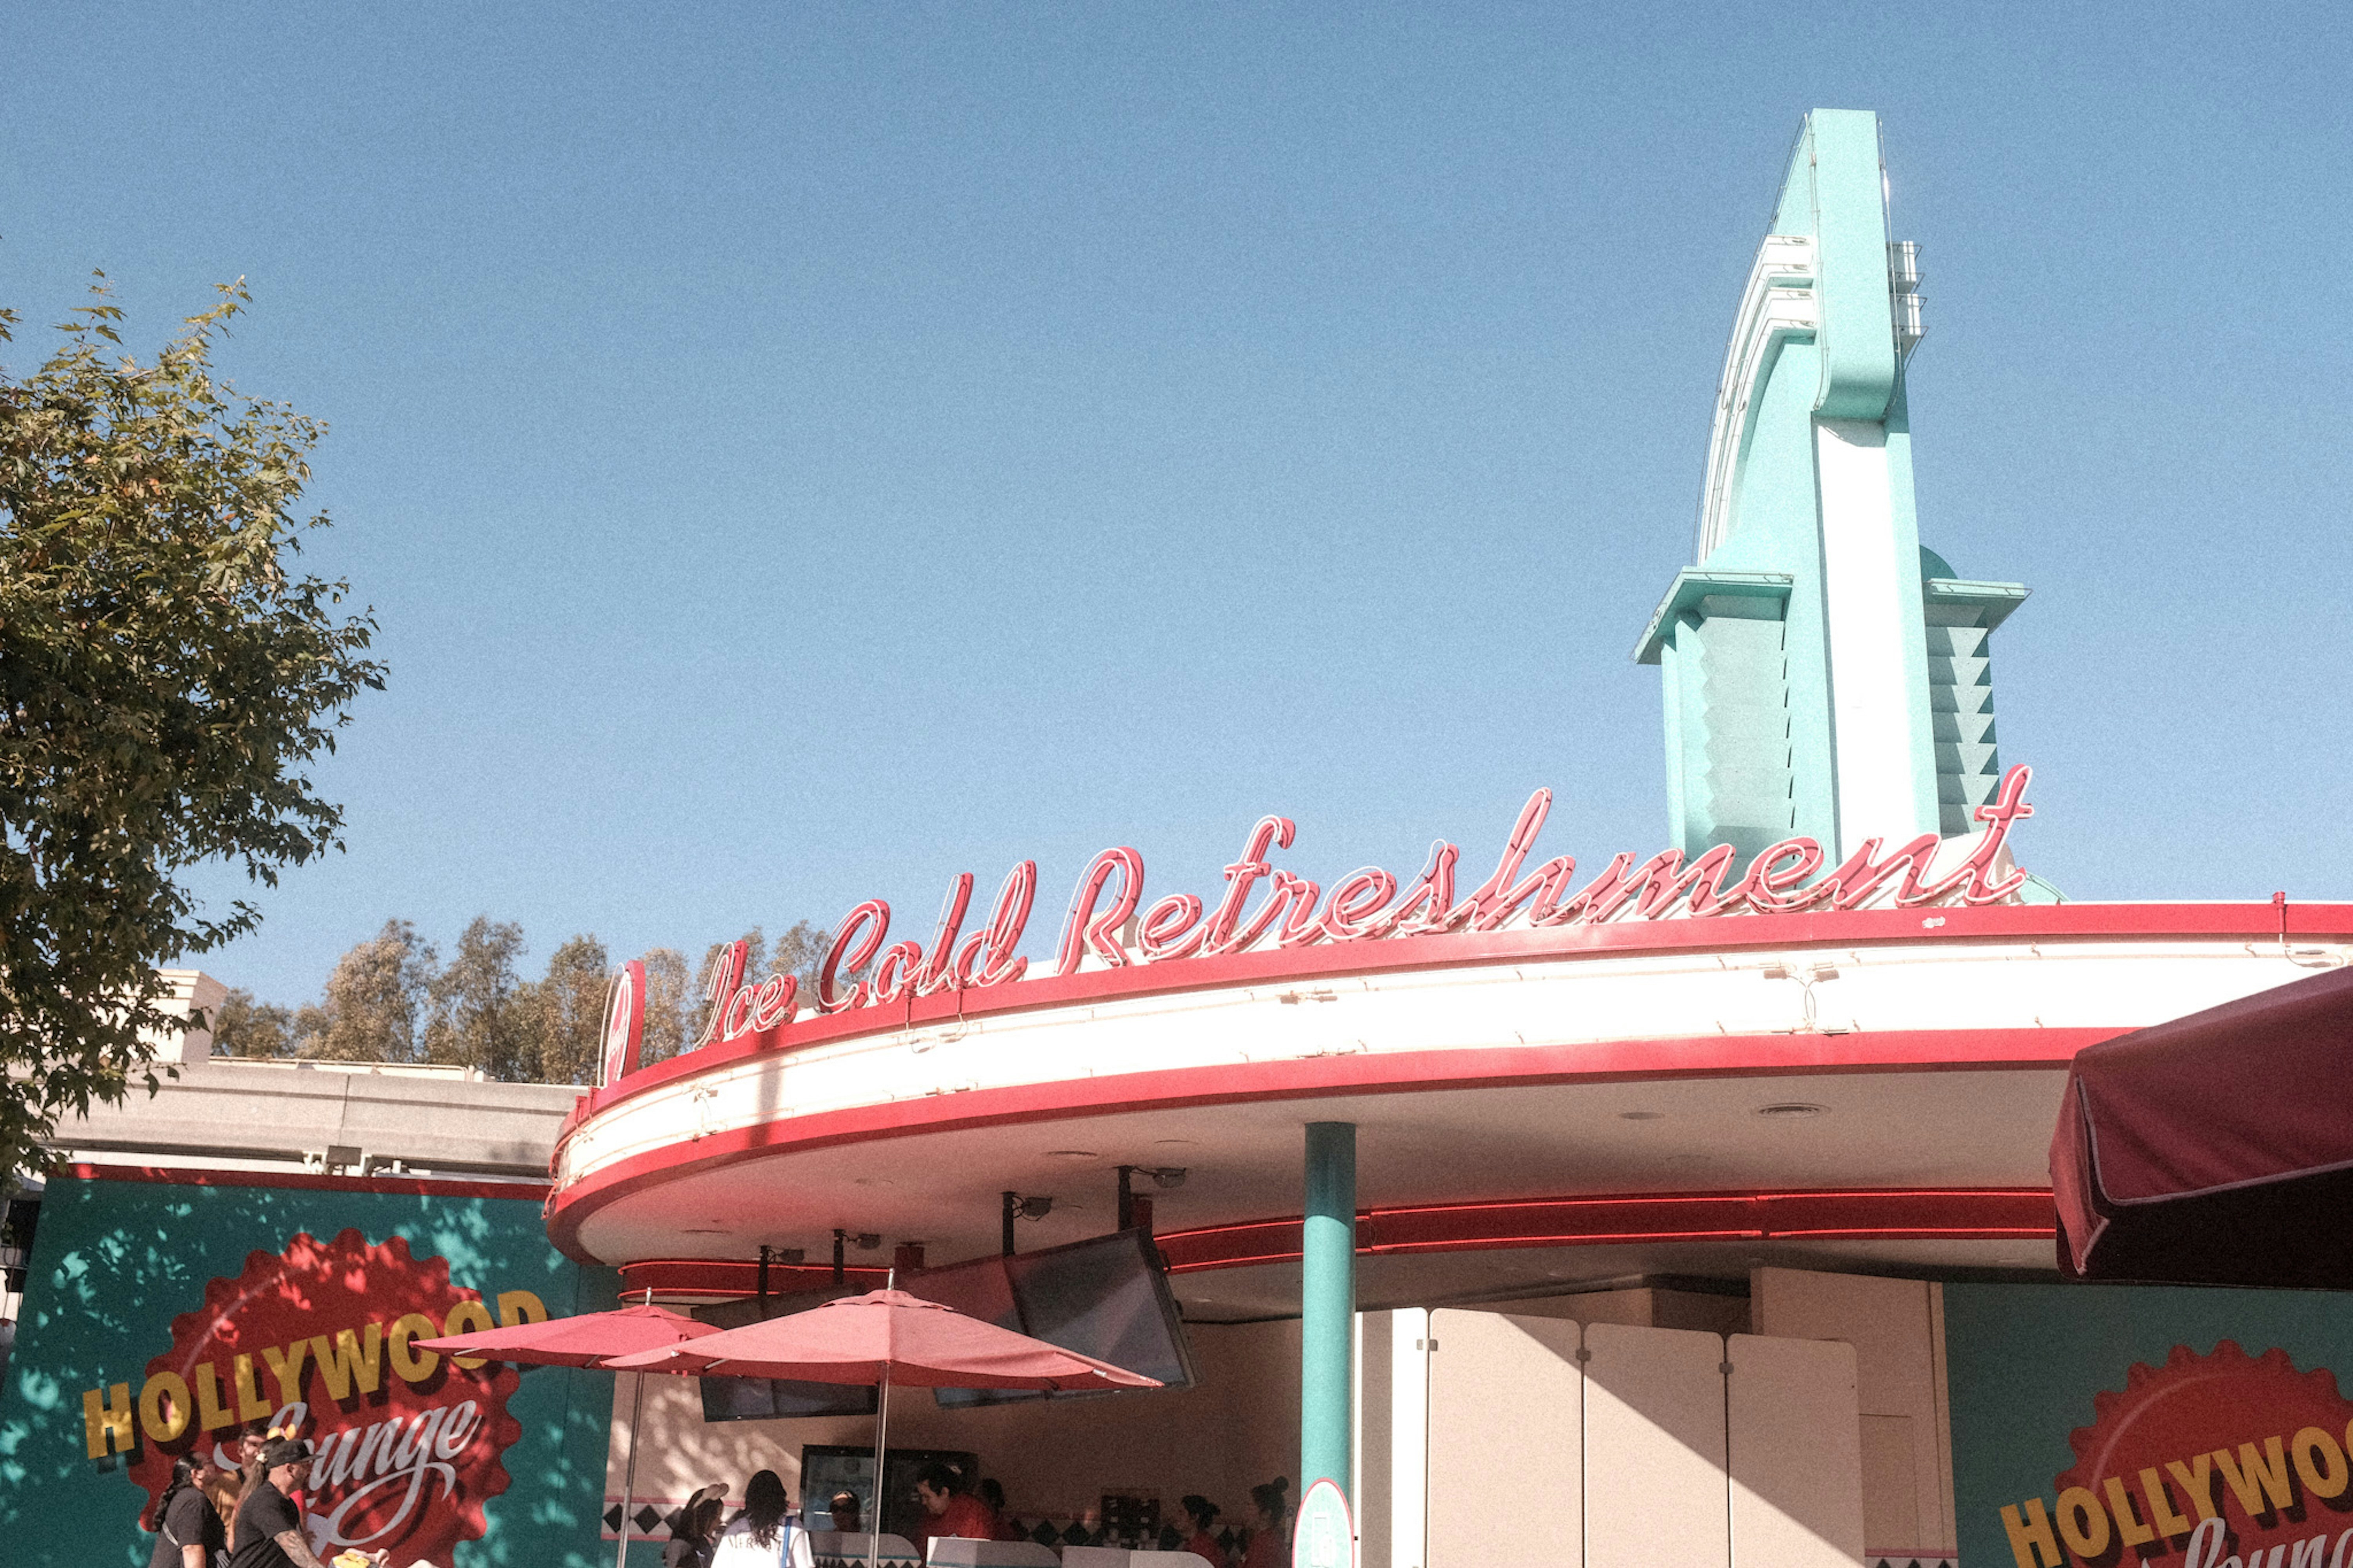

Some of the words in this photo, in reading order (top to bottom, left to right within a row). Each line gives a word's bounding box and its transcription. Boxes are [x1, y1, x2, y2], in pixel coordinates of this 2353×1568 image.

[693, 940, 798, 1051] Ice
[818, 860, 1036, 1014] Cold
[1054, 763, 2035, 976] Refreshment
[213, 1401, 482, 1555] Lunge
[2000, 1418, 2353, 1568] HOLLYWO
